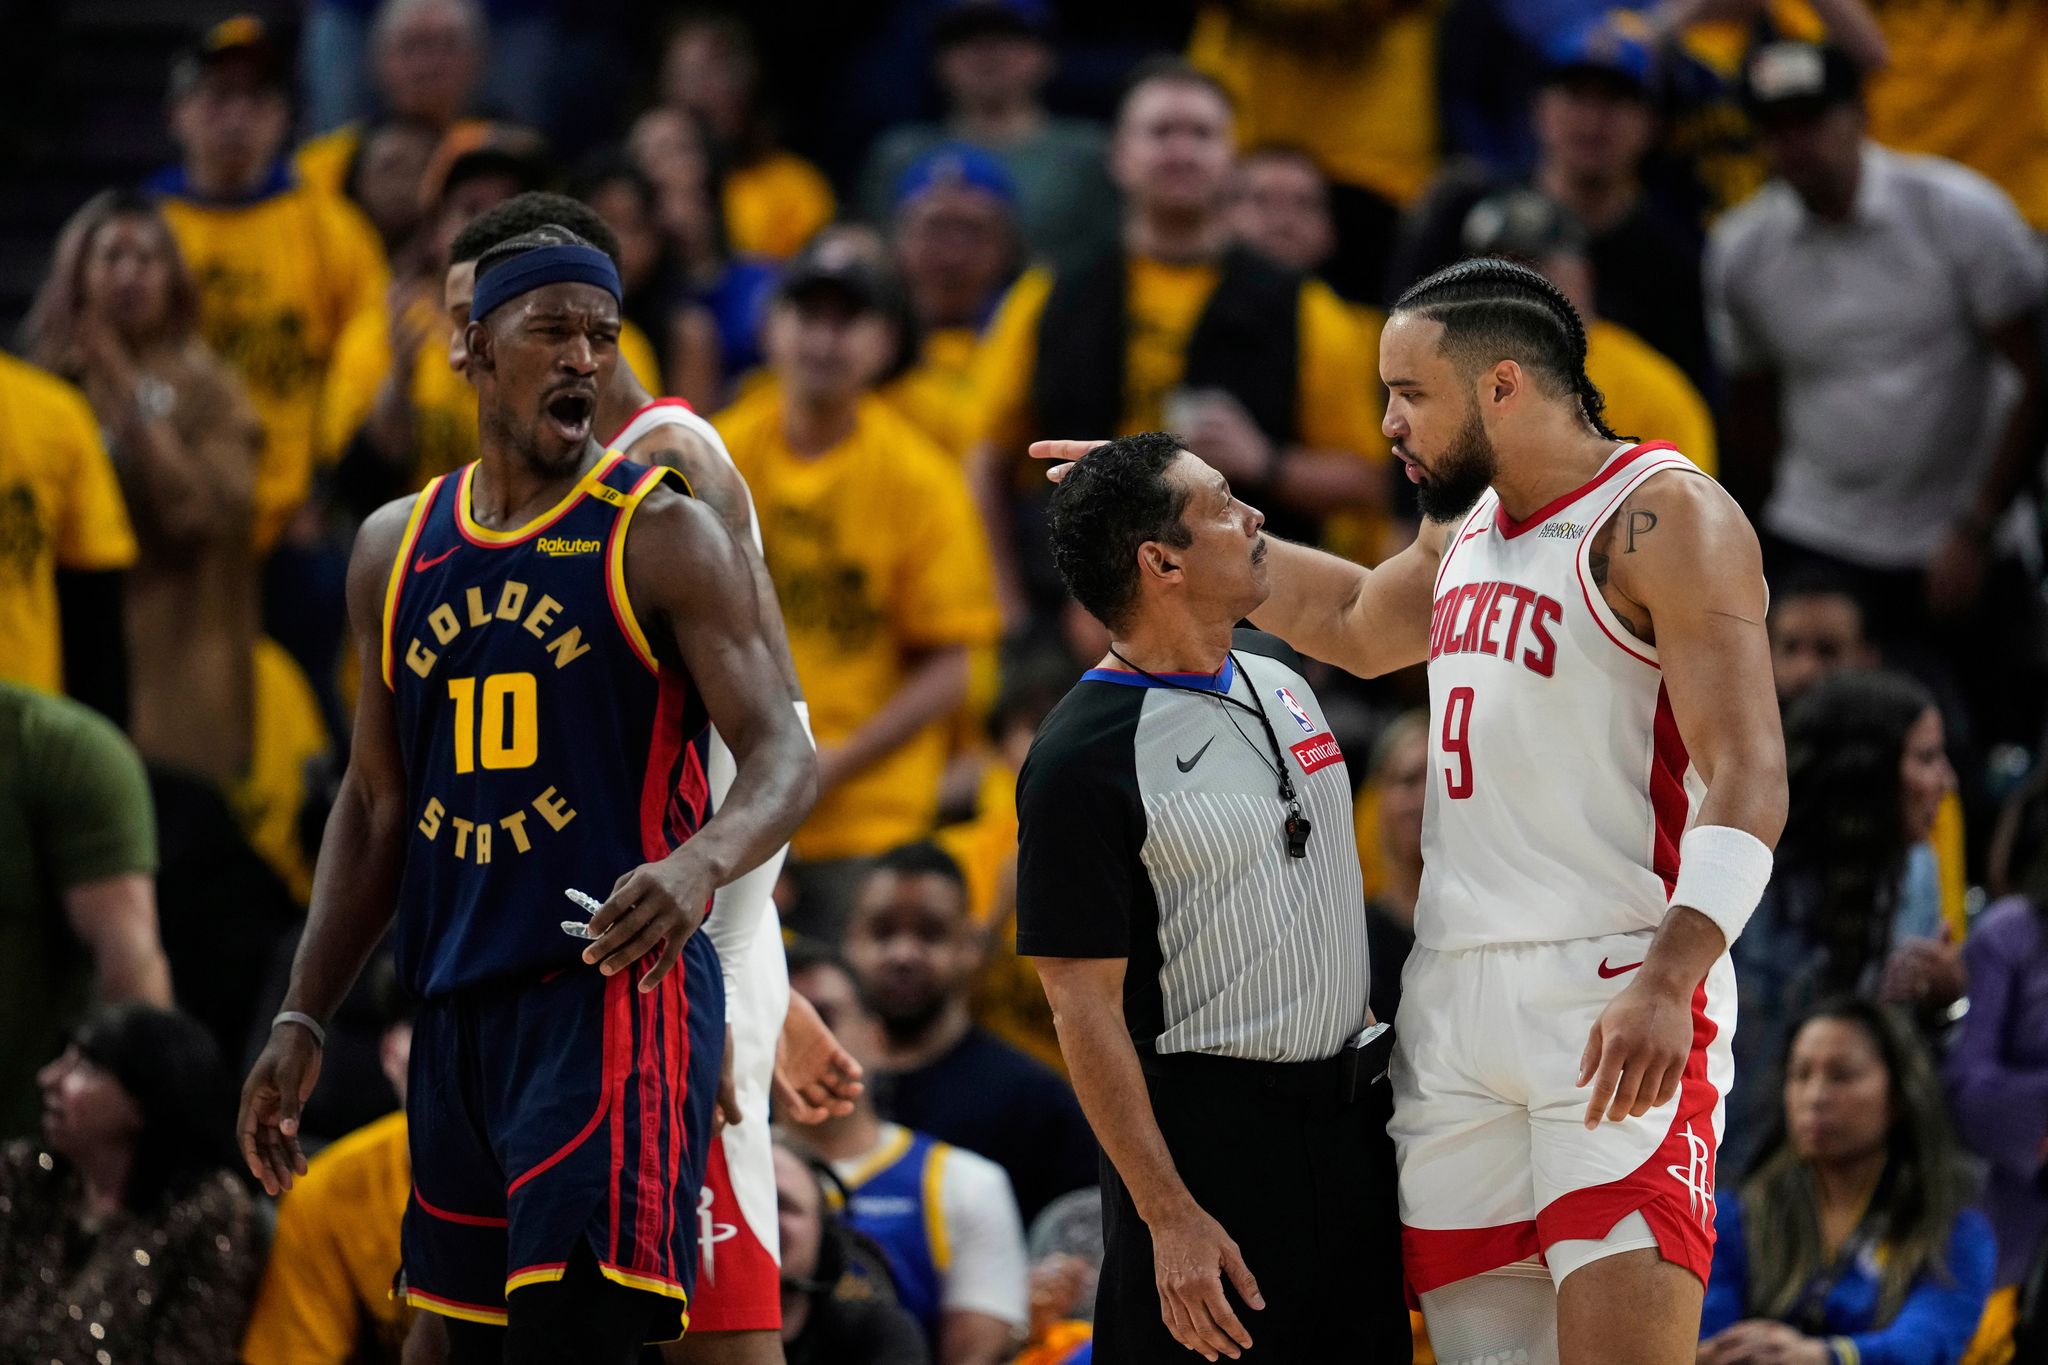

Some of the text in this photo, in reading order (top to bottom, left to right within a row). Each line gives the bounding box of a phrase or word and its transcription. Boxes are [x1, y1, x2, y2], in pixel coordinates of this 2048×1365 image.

[602, 489, 619, 501] 16
[1624, 509, 1657, 554] P
[537, 537, 601, 553] Rakuten
[406, 580, 592, 678] GOLDEN
[448, 672, 538, 774] 10
[1442, 687, 1474, 799] 9
[418, 785, 578, 864] STATE
